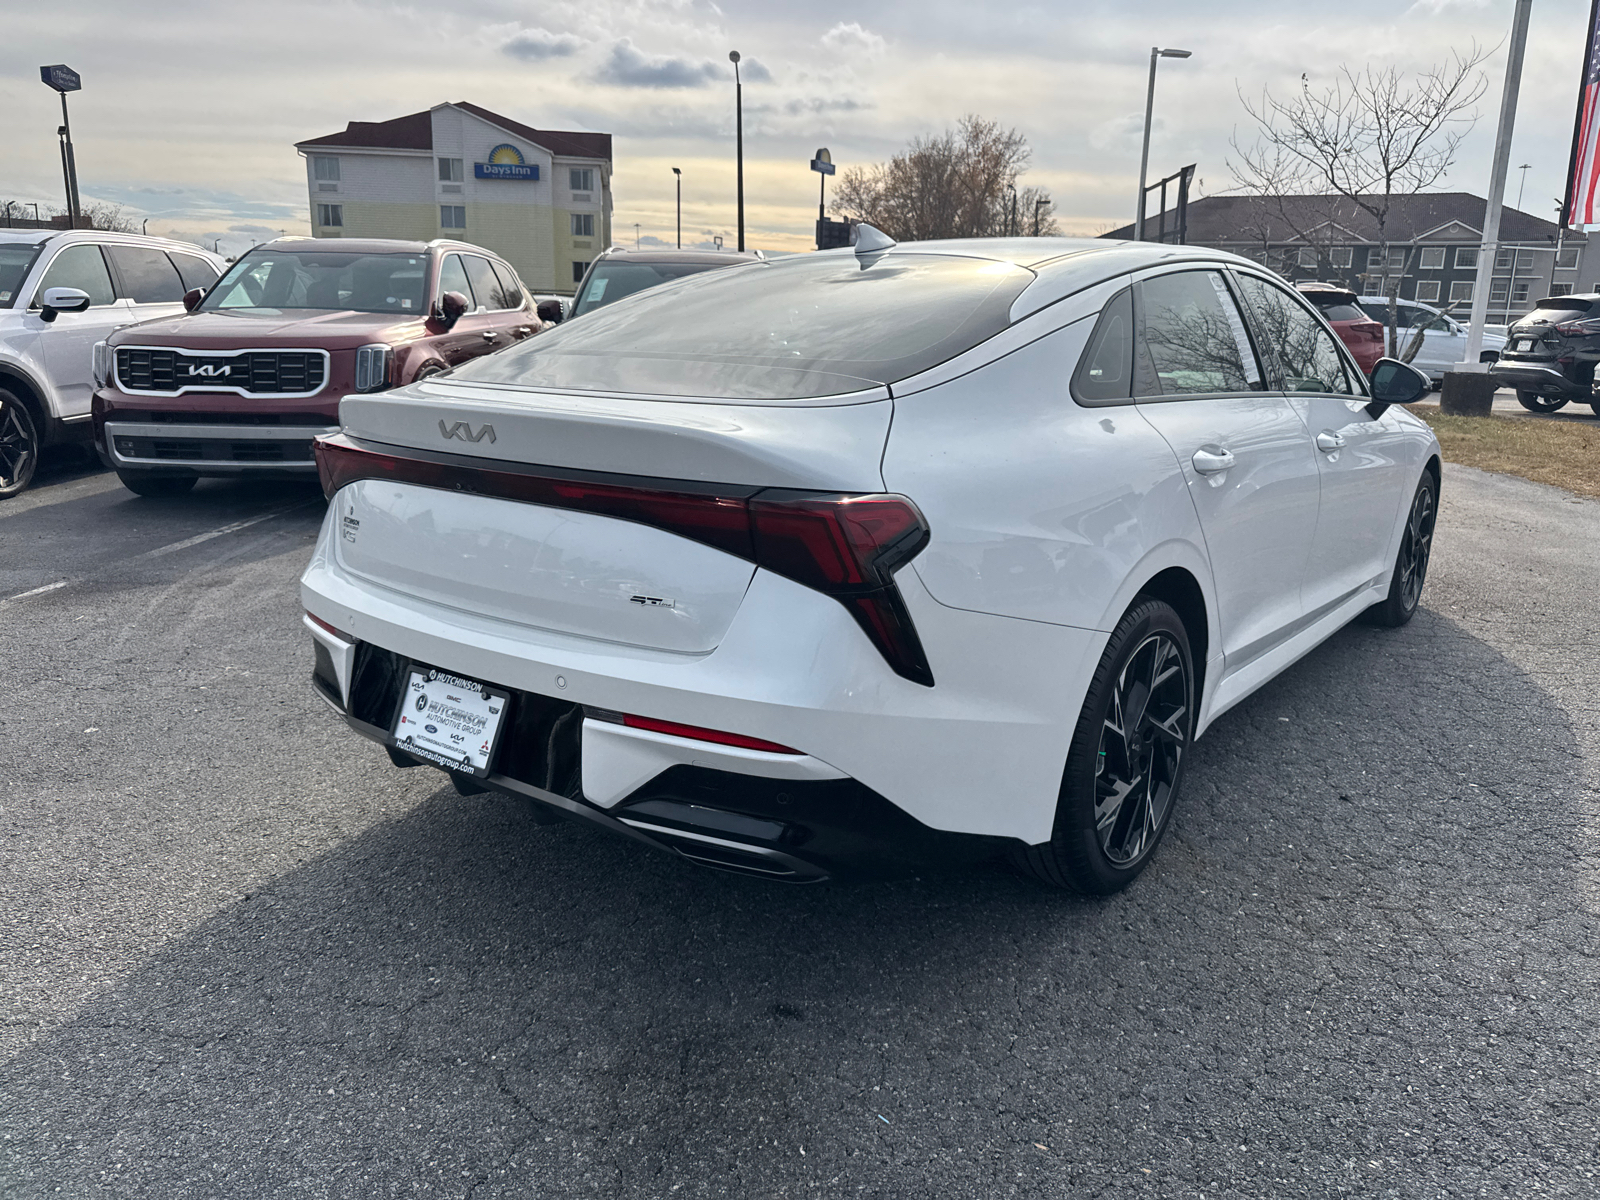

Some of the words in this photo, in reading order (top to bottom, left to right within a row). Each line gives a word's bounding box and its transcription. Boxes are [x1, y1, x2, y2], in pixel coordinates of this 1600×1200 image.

[483, 165, 511, 174] Days
[512, 167, 531, 175] Inn
[188, 364, 231, 377] KIA
[438, 418, 497, 444] KIA
[437, 673, 483, 692] HUTCHINSON
[447, 695, 461, 703] GMC
[426, 713, 461, 730] AUTOMOTIVE
[461, 724, 482, 736] GROUP
